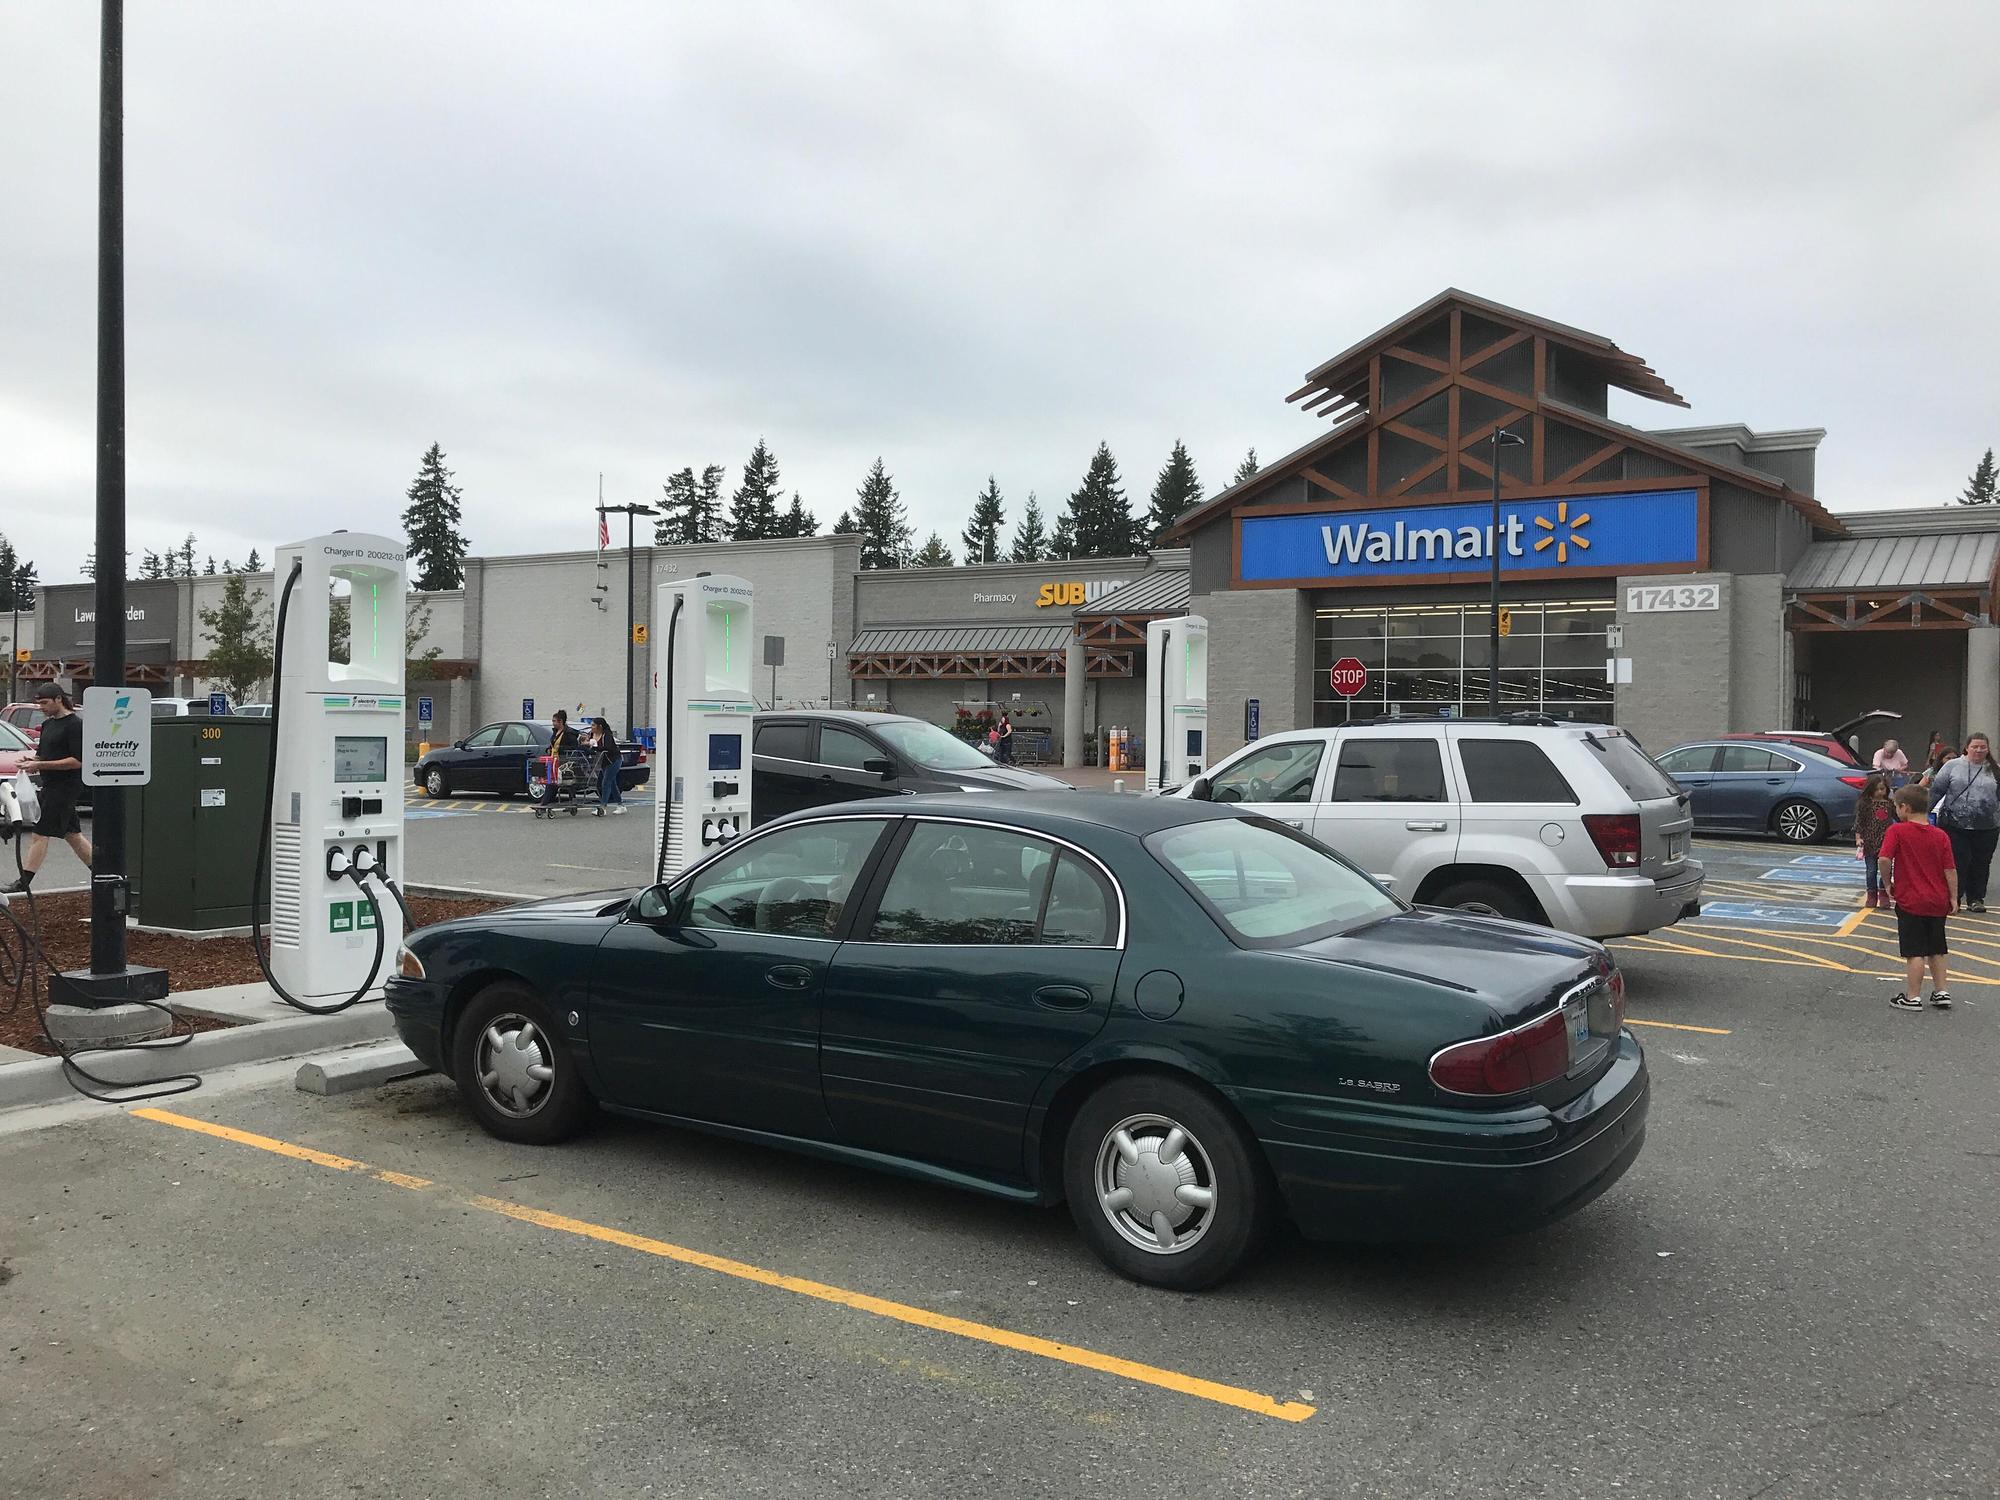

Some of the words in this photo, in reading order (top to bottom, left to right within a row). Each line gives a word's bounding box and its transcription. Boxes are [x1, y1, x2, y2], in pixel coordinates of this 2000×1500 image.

[1321, 514, 1524, 565] Walmart
[323, 546, 354, 557] Charger
[355, 549, 364, 557] ID
[367, 550, 404, 561] 200212-03
[655, 563, 679, 574] 17432
[973, 592, 1017, 605] Pharmacy
[1631, 588, 1714, 610] 17432
[1333, 669, 1364, 684] STOP
[202, 727, 221, 739] 300
[94, 740, 139, 750] electrify
[1357, 1079, 1401, 1091] SABRE
